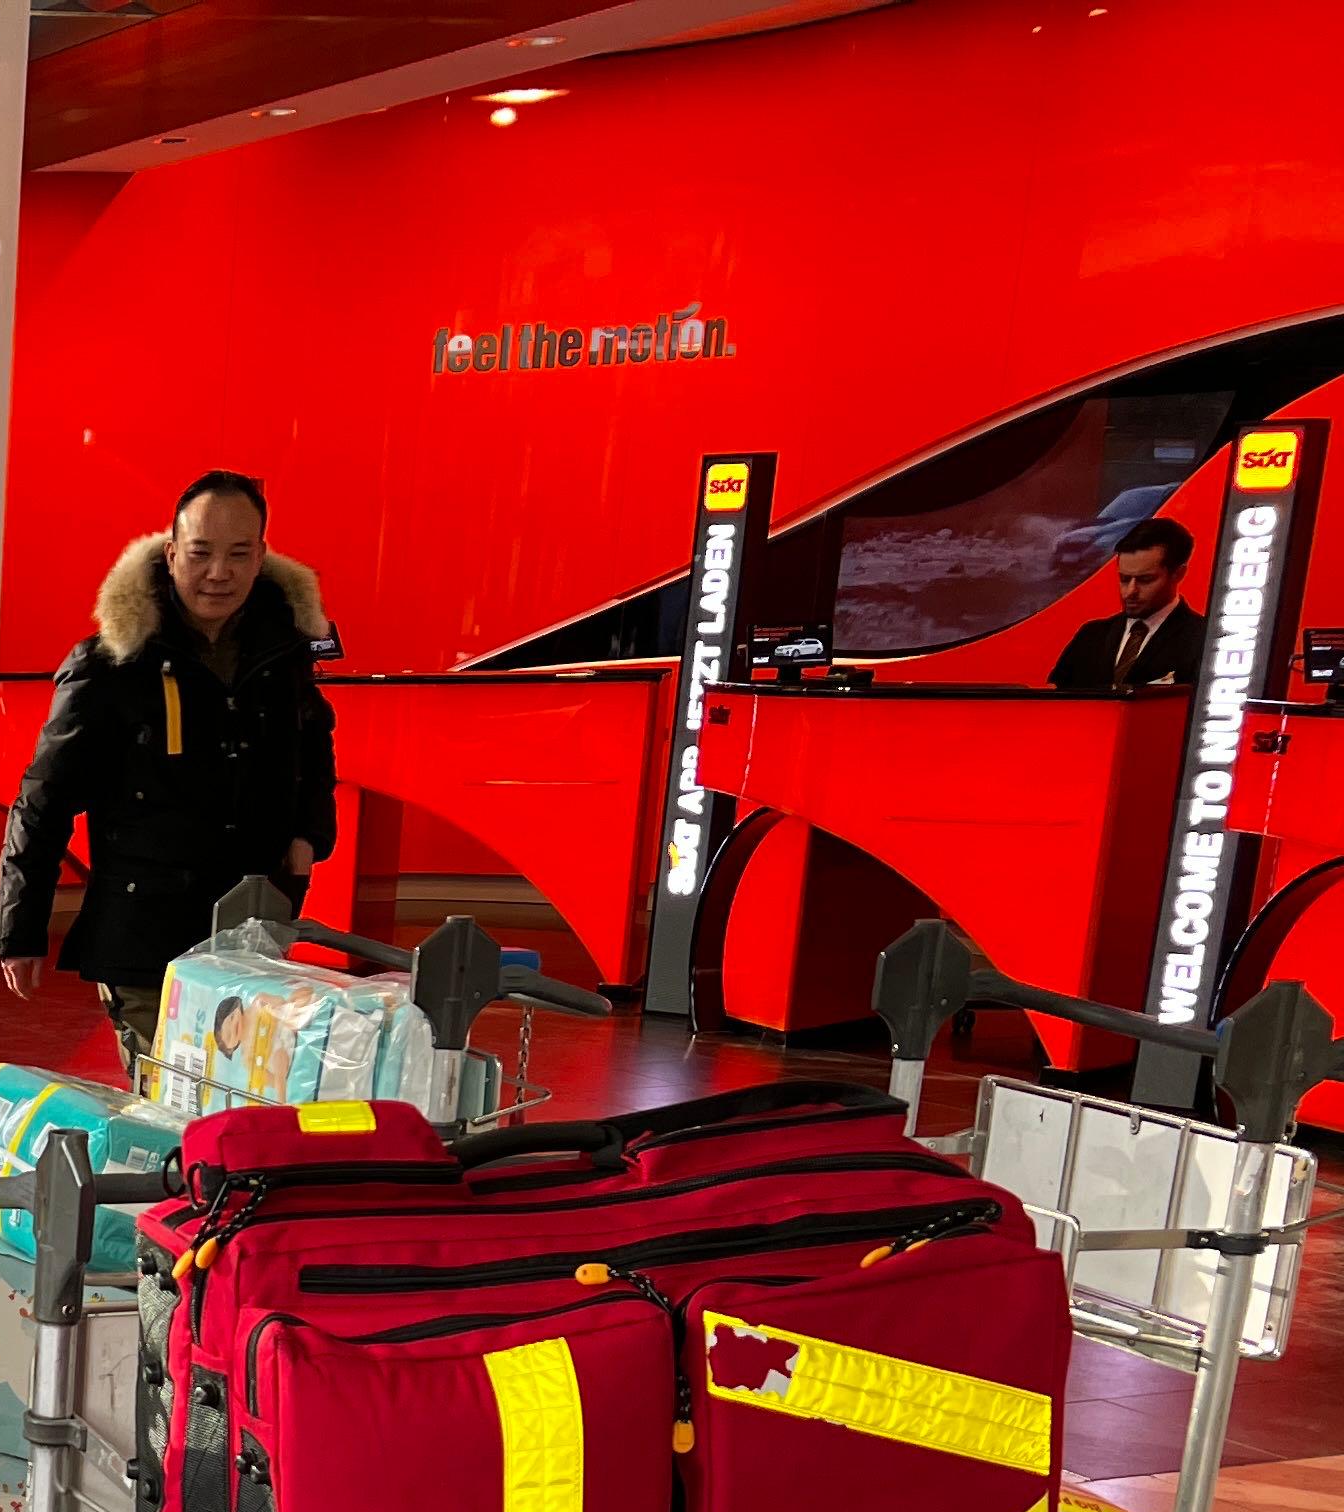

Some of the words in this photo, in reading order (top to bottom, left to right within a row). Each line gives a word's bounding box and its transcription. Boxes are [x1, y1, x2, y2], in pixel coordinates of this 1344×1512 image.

[432, 324, 512, 374] feel
[517, 323, 583, 369] the
[676, 744, 704, 816] APP
[697, 523, 736, 633] LADEN
[1199, 504, 1278, 766] NUREMBERG
[1190, 769, 1230, 824] TO
[1158, 830, 1223, 1026] WELCOME
